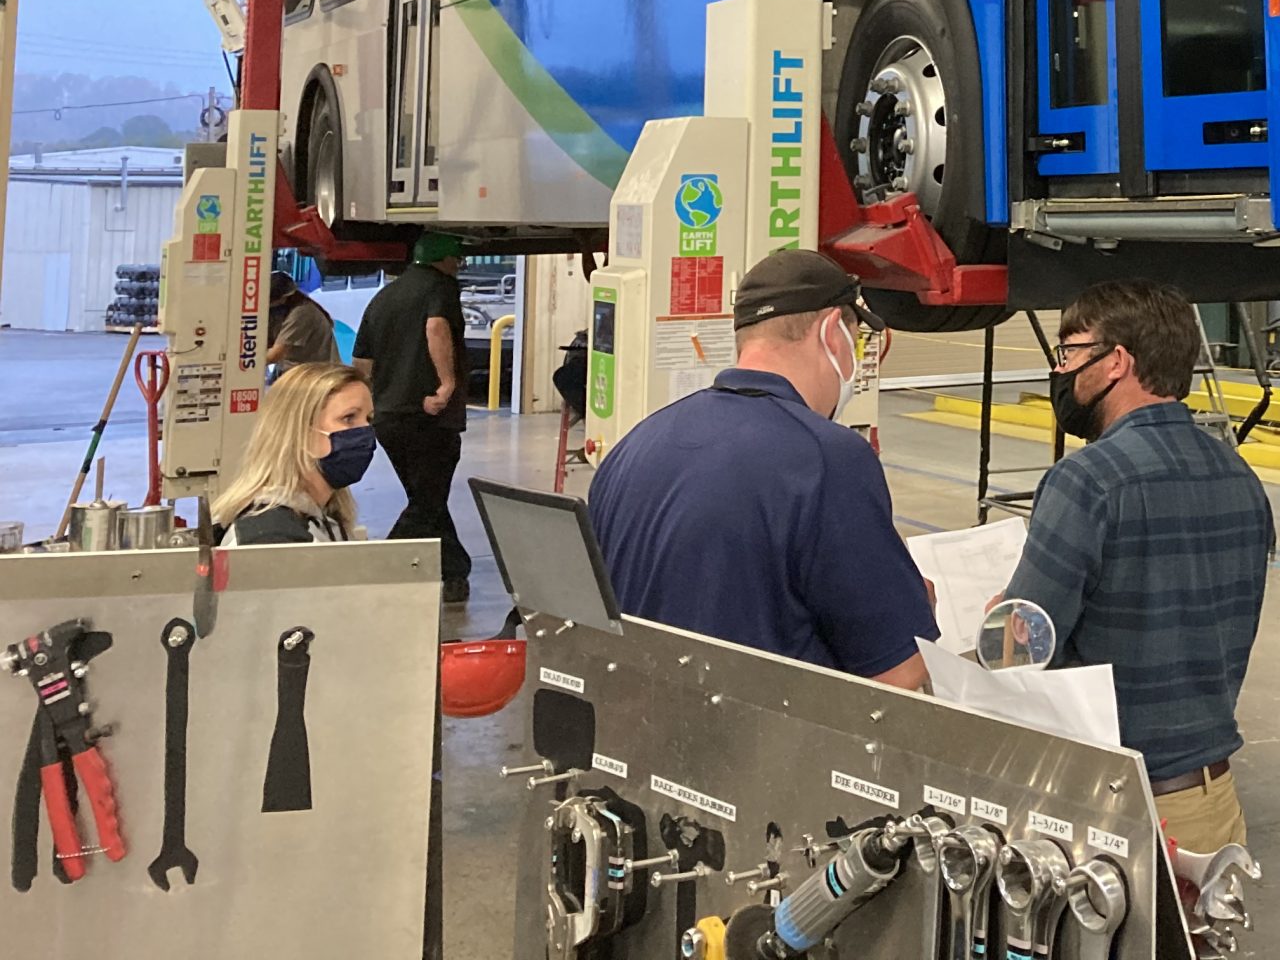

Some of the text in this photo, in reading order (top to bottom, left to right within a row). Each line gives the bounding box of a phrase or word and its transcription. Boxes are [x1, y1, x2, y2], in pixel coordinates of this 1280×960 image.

[683, 231, 714, 240] EARTH
[239, 133, 267, 371] stertil KONI EARTHLIFT
[682, 240, 713, 251] LIFT
[232, 390, 258, 402] 18500
[834, 775, 896, 802] DIE GRINDER
[928, 790, 962, 807] 1-1/16"
[973, 801, 1004, 818] 1-1/8"
[1031, 815, 1069, 834] 1-3/16"
